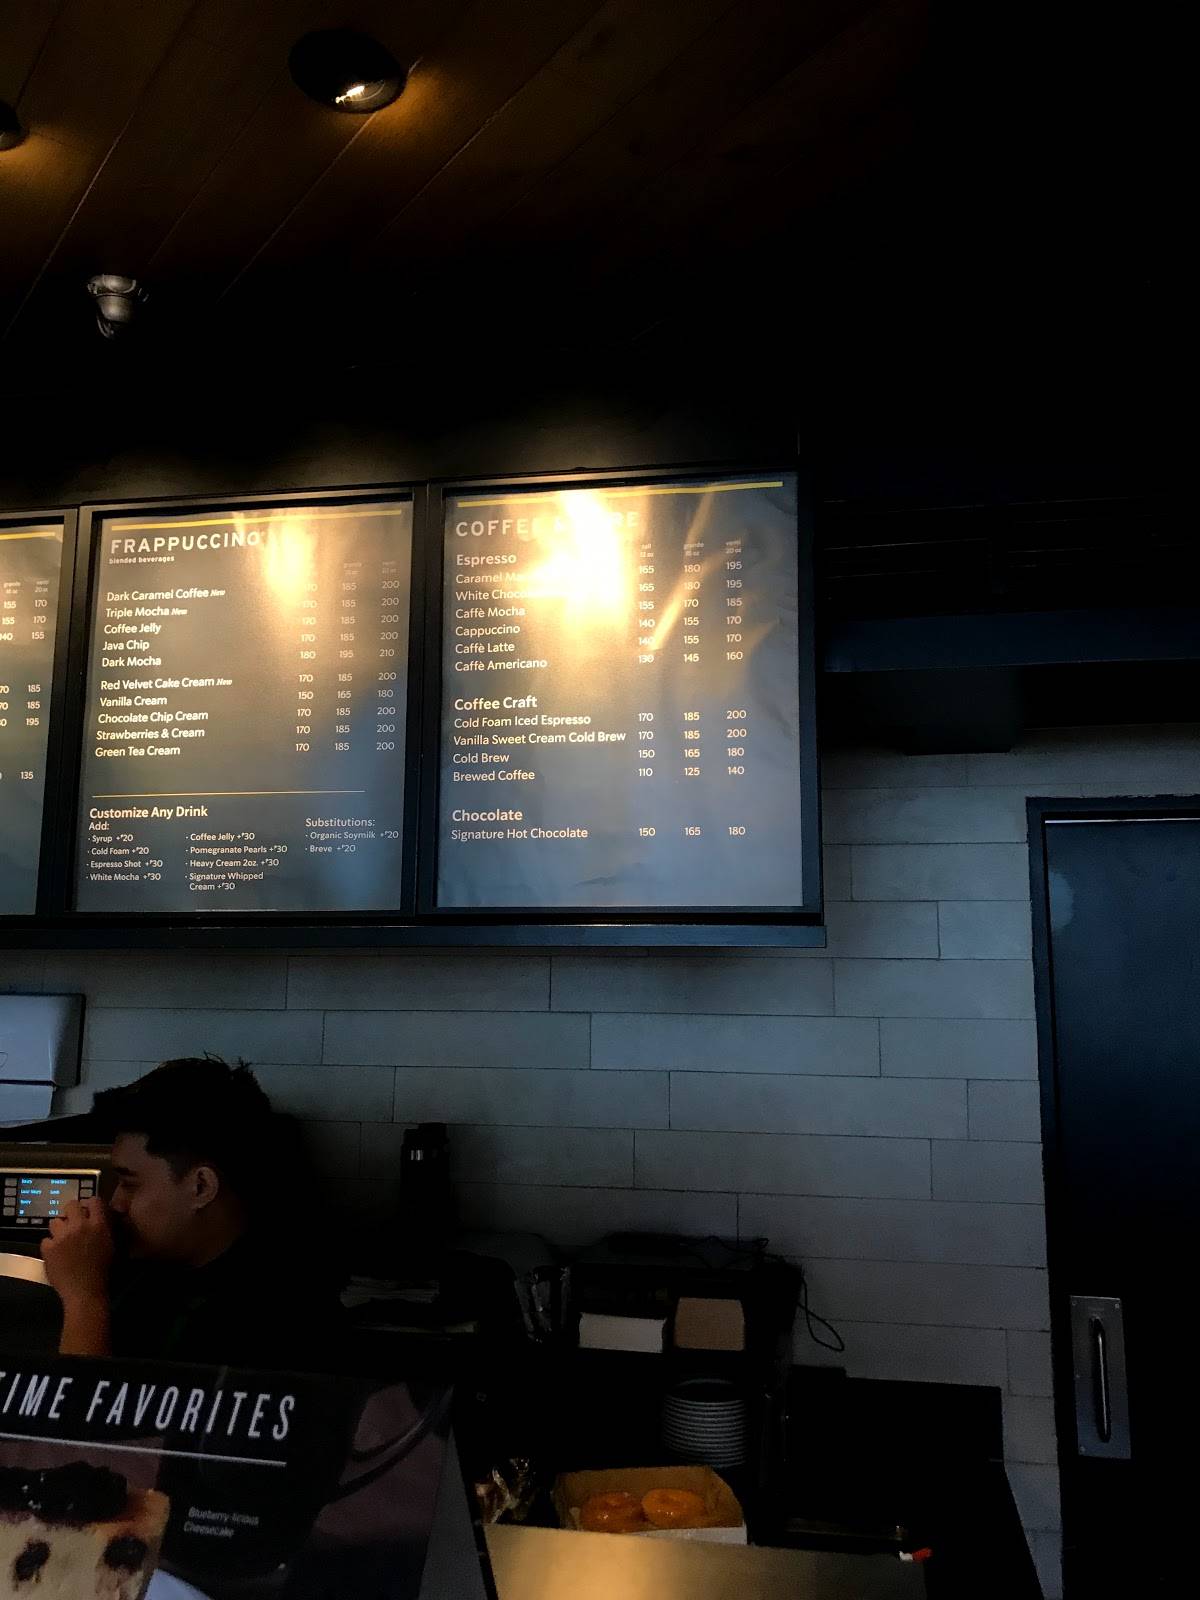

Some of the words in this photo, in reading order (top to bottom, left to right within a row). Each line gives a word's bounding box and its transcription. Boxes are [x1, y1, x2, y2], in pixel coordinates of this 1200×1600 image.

[111, 531, 261, 554] FRAPPUCCINO
[138, 555, 175, 563] beverages
[457, 553, 516, 566] Espresso
[639, 565, 654, 574] 165
[684, 564, 700, 573] 180
[726, 561, 742, 570] 195
[456, 572, 502, 584] Caramel
[107, 592, 129, 601] Dark
[132, 589, 174, 600] Caramel
[176, 588, 209, 598] Coffee
[343, 582, 357, 591] 185
[382, 580, 399, 589] 200
[456, 590, 489, 601] White
[639, 583, 654, 592] 165
[684, 581, 700, 591] 180
[727, 580, 742, 589] 195
[106, 608, 132, 619] Triple
[135, 606, 169, 616] Mocha
[342, 599, 356, 608] 185
[381, 597, 399, 606] 200
[455, 608, 485, 618] Caffè
[488, 606, 525, 617] Mocha
[684, 599, 698, 608] 170
[726, 598, 742, 607] 185
[104, 624, 137, 634] Coffee
[139, 623, 161, 635] Jelly
[341, 616, 355, 625] 185
[381, 614, 398, 623] 200
[455, 624, 520, 637] Cappuccino
[639, 619, 655, 628] 140
[684, 617, 699, 626] 155
[726, 616, 741, 625] 170
[102, 641, 124, 650] Java
[127, 639, 149, 651] Chip
[301, 633, 315, 642] 170
[340, 633, 354, 641] 185
[380, 631, 398, 640] 200
[455, 643, 485, 654] Caffè
[487, 642, 515, 652] Latte
[684, 635, 699, 644] 155
[726, 634, 741, 643] 170
[102, 657, 124, 667] Dark
[127, 655, 161, 666] Mocha
[300, 650, 316, 659] 180
[340, 650, 353, 658] 195
[379, 648, 394, 657] 210
[455, 661, 485, 672] Caffè
[487, 658, 547, 670] Americano
[727, 651, 743, 661] 160
[101, 679, 120, 690] Red
[122, 679, 153, 689] Velvet
[155, 678, 179, 688] Cake
[182, 676, 214, 688] Cream
[299, 673, 313, 683] 170
[338, 672, 353, 682] 185
[378, 672, 396, 681] 200
[27, 701, 40, 709] 185
[100, 696, 132, 706] Vanilla
[134, 695, 167, 706] Cream
[298, 691, 313, 700] 150
[338, 690, 351, 699] 165
[377, 689, 393, 698] 180
[455, 698, 500, 711] Coffee
[503, 695, 537, 708] Craft
[26, 718, 39, 726] 195
[98, 712, 148, 724] Chocolate
[150, 711, 173, 724] Chip
[175, 710, 208, 721] Cream
[297, 708, 311, 717] 170
[336, 707, 350, 716] 185
[377, 706, 395, 715] 200
[454, 718, 479, 728] Cold
[482, 717, 511, 727] Foam
[515, 715, 538, 726] Iced
[541, 714, 591, 727] Espresso
[639, 713, 653, 722] 170
[684, 712, 699, 721] 185
[727, 710, 746, 719] 200
[96, 729, 159, 740] Strawberries
[162, 728, 169, 738] &
[171, 727, 205, 738] Cream
[296, 725, 310, 734] 170
[336, 725, 350, 734] 185
[376, 724, 395, 733] 200
[454, 735, 489, 745] Vanilla
[492, 734, 526, 745] Sweet
[529, 733, 566, 743] Cream
[569, 731, 595, 742] Cold
[597, 731, 626, 742] Brew
[639, 731, 653, 740] 170
[684, 730, 700, 739] 185
[727, 729, 747, 738] 200
[95, 747, 125, 757] Green
[128, 746, 145, 757] Tea
[147, 745, 180, 756] Cream
[296, 742, 309, 752] 170
[335, 742, 349, 751] 185
[376, 742, 394, 751] 200
[453, 753, 478, 763] Cold
[481, 752, 509, 762] Brew
[639, 749, 655, 758] 150
[684, 749, 700, 758] 165
[727, 747, 744, 756] 180
[453, 771, 495, 782] Brewed
[498, 770, 535, 780] Coffee
[639, 768, 653, 777] 110
[684, 767, 700, 776] 125
[728, 766, 744, 775] 140
[90, 807, 149, 819] Customize
[151, 806, 173, 819] Any
[176, 806, 208, 817] Drink
[452, 809, 522, 822] Chocolate
[89, 821, 110, 831] Add:
[305, 818, 375, 827] Substitutions:
[92, 835, 112, 843] Syrup
[190, 832, 217, 841] Coffee
[219, 832, 235, 842] Jelly
[310, 831, 342, 841] Organic
[344, 830, 375, 841] Soymilk
[451, 829, 504, 841] Signature
[507, 828, 527, 839] Hot
[530, 827, 588, 838] Chocolate
[639, 827, 655, 836] 150
[684, 827, 700, 836] 165
[729, 826, 745, 835] 180
[91, 847, 109, 856] Cold
[110, 847, 130, 855] Foam
[190, 845, 241, 855] Pomegranate
[244, 845, 267, 854] Pearls
[310, 844, 332, 853] Breve
[91, 860, 122, 869] Espresso
[124, 860, 141, 868] Shot
[190, 859, 214, 868] Heavy
[216, 858, 241, 867] Cream
[243, 858, 258, 867] 2oz.
[90, 873, 112, 882] White
[114, 872, 139, 881] Mocha
[190, 872, 225, 882] Signature
[227, 871, 263, 882] Whipped
[189, 882, 215, 891] Cream
[0, 1371, 73, 1419] IME
[86, 1380, 296, 1440] FAVORITES
